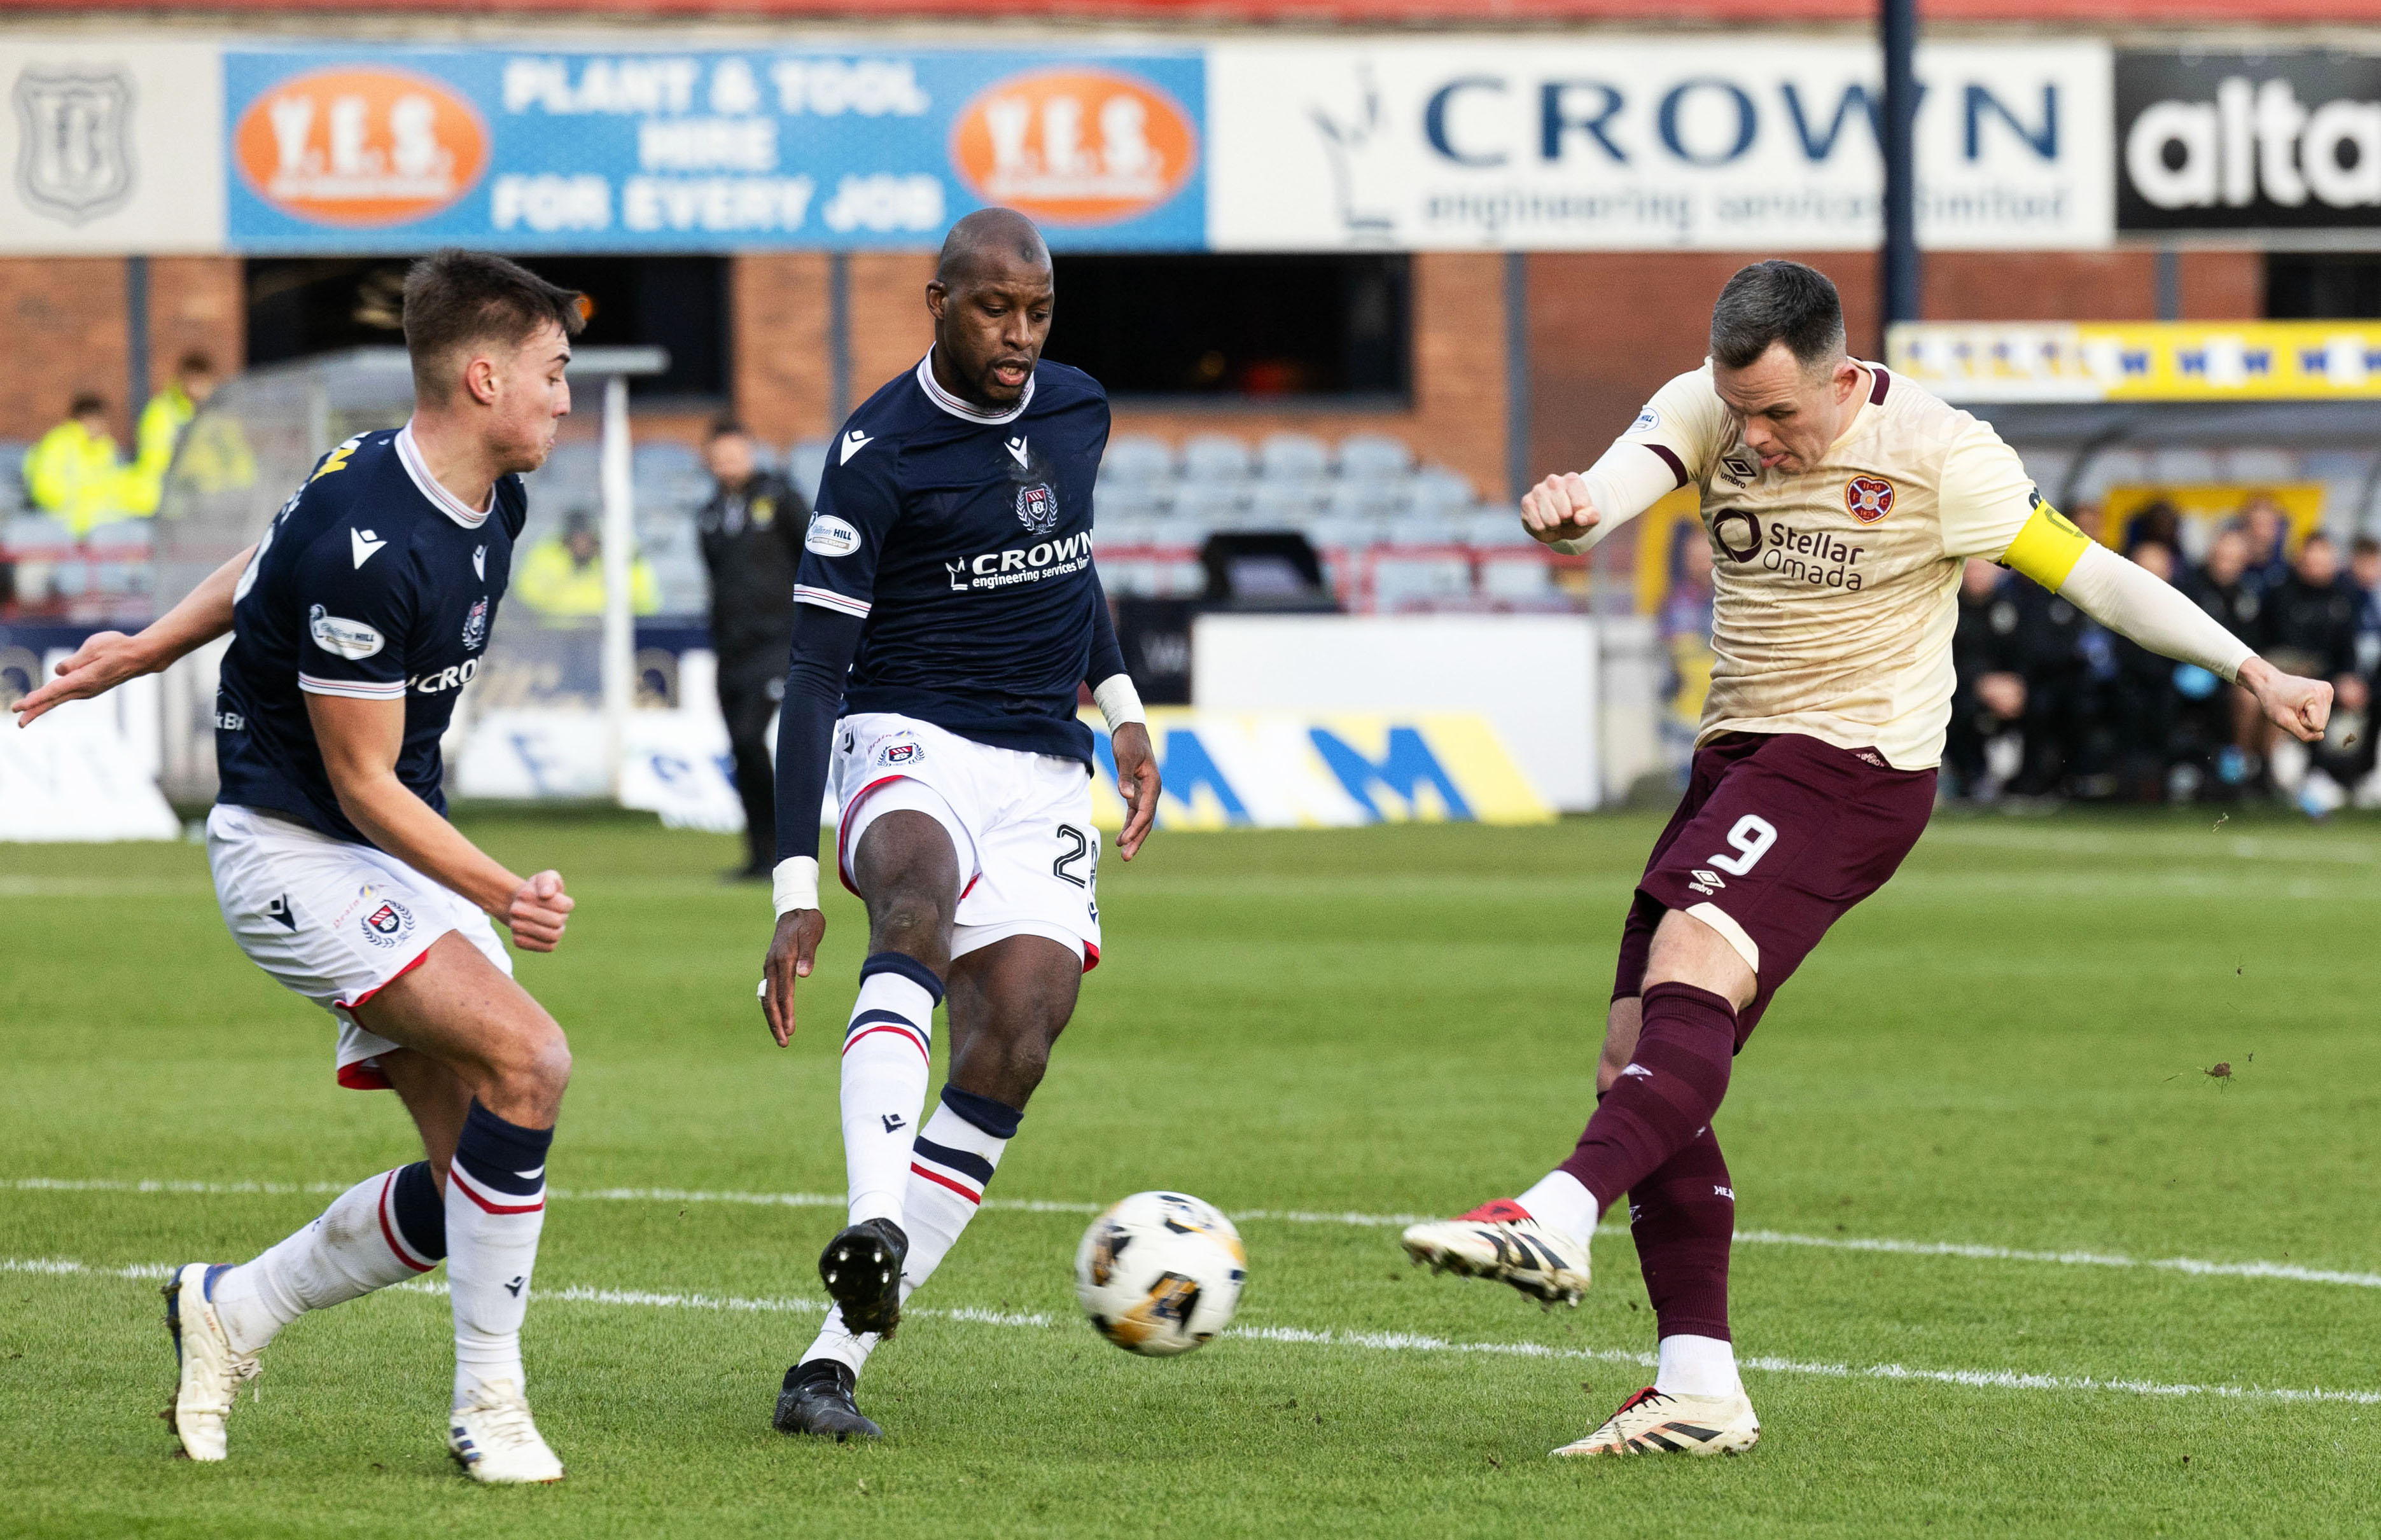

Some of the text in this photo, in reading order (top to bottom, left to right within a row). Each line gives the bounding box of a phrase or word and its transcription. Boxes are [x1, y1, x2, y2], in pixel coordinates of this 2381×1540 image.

[505, 60, 930, 115] PLANT & TOOL
[1423, 76, 2060, 168] CROWN
[640, 119, 777, 170] HIRE
[492, 176, 610, 230] FOR
[622, 176, 813, 231] EVERY
[823, 176, 945, 230] JOB
[1423, 185, 1693, 243] engineering
[1917, 185, 2069, 224] imited
[1721, 472, 1746, 489] umbro
[834, 528, 852, 541] HILL
[972, 529, 1093, 575] CROWN
[1770, 522, 1864, 565] Stellar
[972, 570, 1040, 589] engineering
[1042, 562, 1077, 579] services
[1763, 549, 1862, 591] Omada
[417, 655, 483, 693] CRO
[1707, 814, 1778, 876] 9
[1688, 882, 1714, 896] umbro
